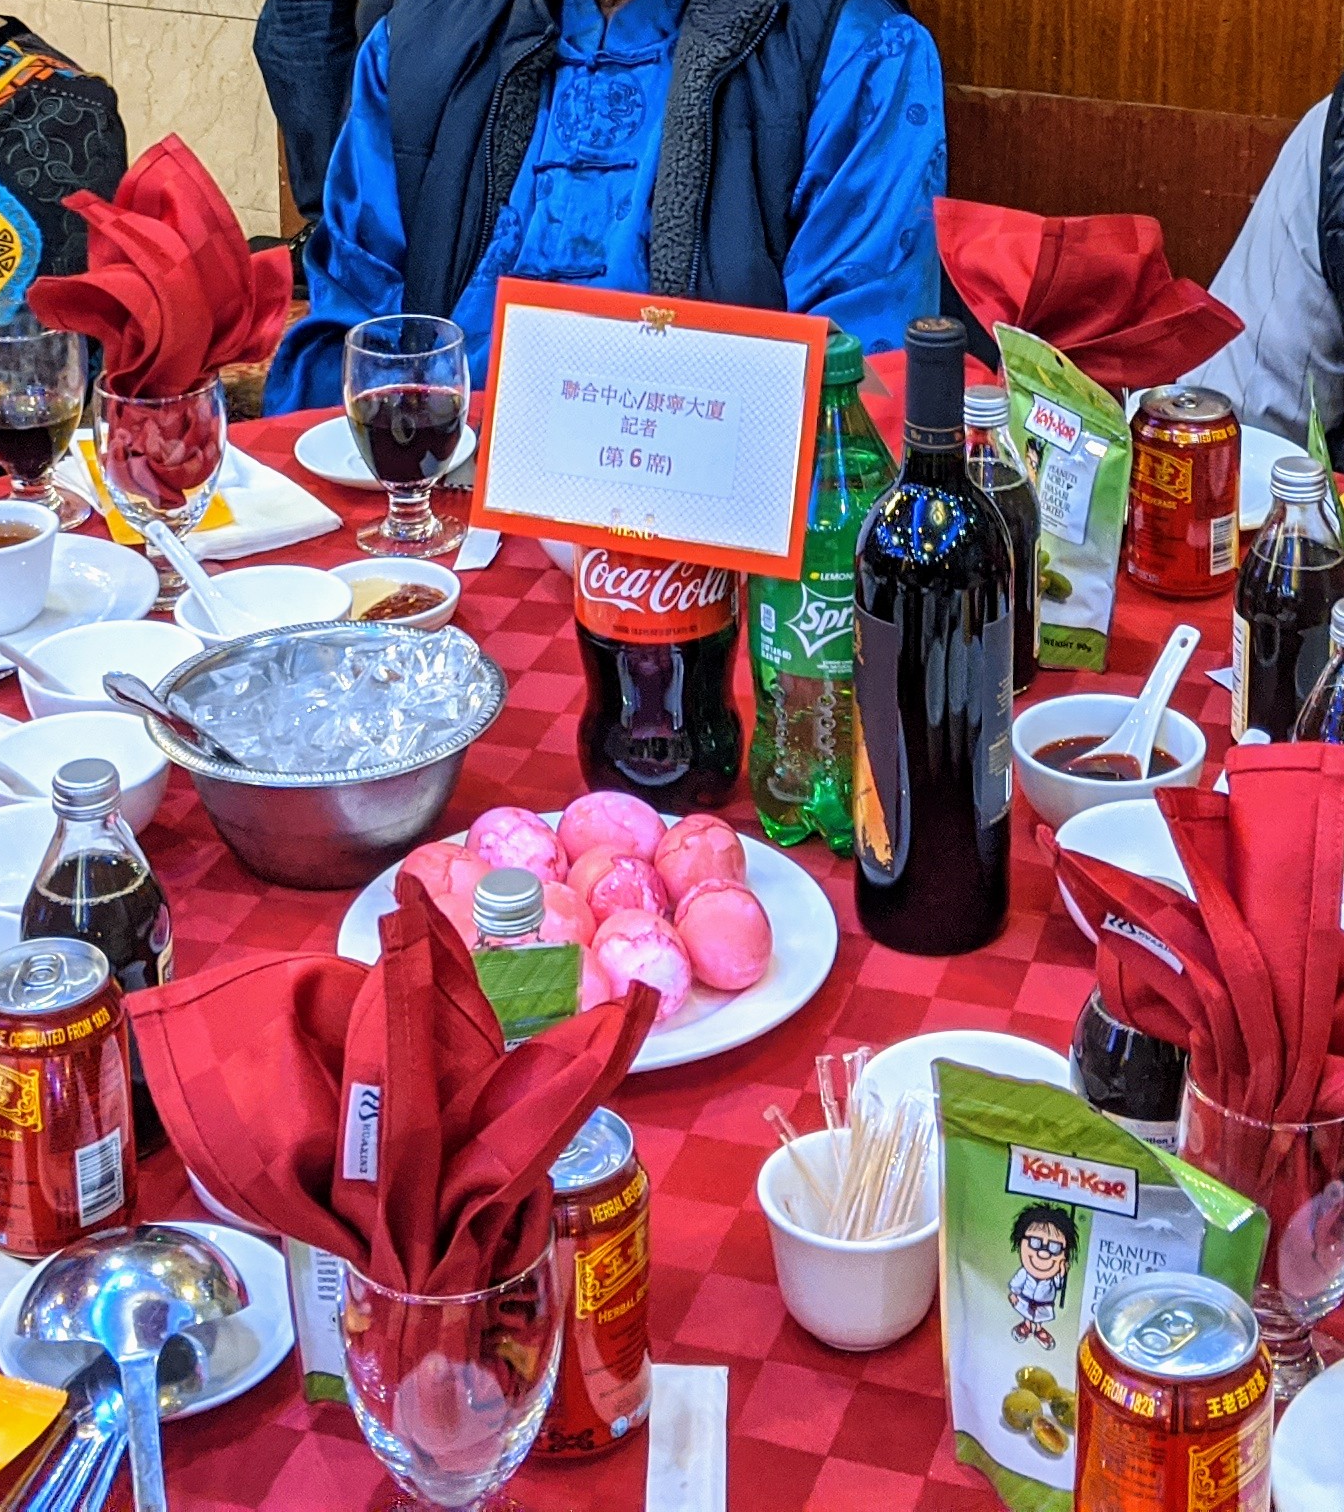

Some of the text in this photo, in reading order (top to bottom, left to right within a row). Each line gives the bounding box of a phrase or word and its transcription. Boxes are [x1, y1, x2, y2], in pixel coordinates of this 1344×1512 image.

[621, 416, 657, 438] 記者
[607, 523, 655, 540] MENU
[580, 548, 728, 613] Coca-Cola
[67, 1016, 94, 1042] FROM
[92, 1007, 111, 1029] 1828
[1022, 1154, 1127, 1201] Koh-Kae
[591, 1192, 627, 1225] HERBAL
[1096, 1255, 1140, 1276] NORI
[1099, 1239, 1167, 1267] PEANUTS
[1099, 1374, 1156, 1419] FROM 1828
